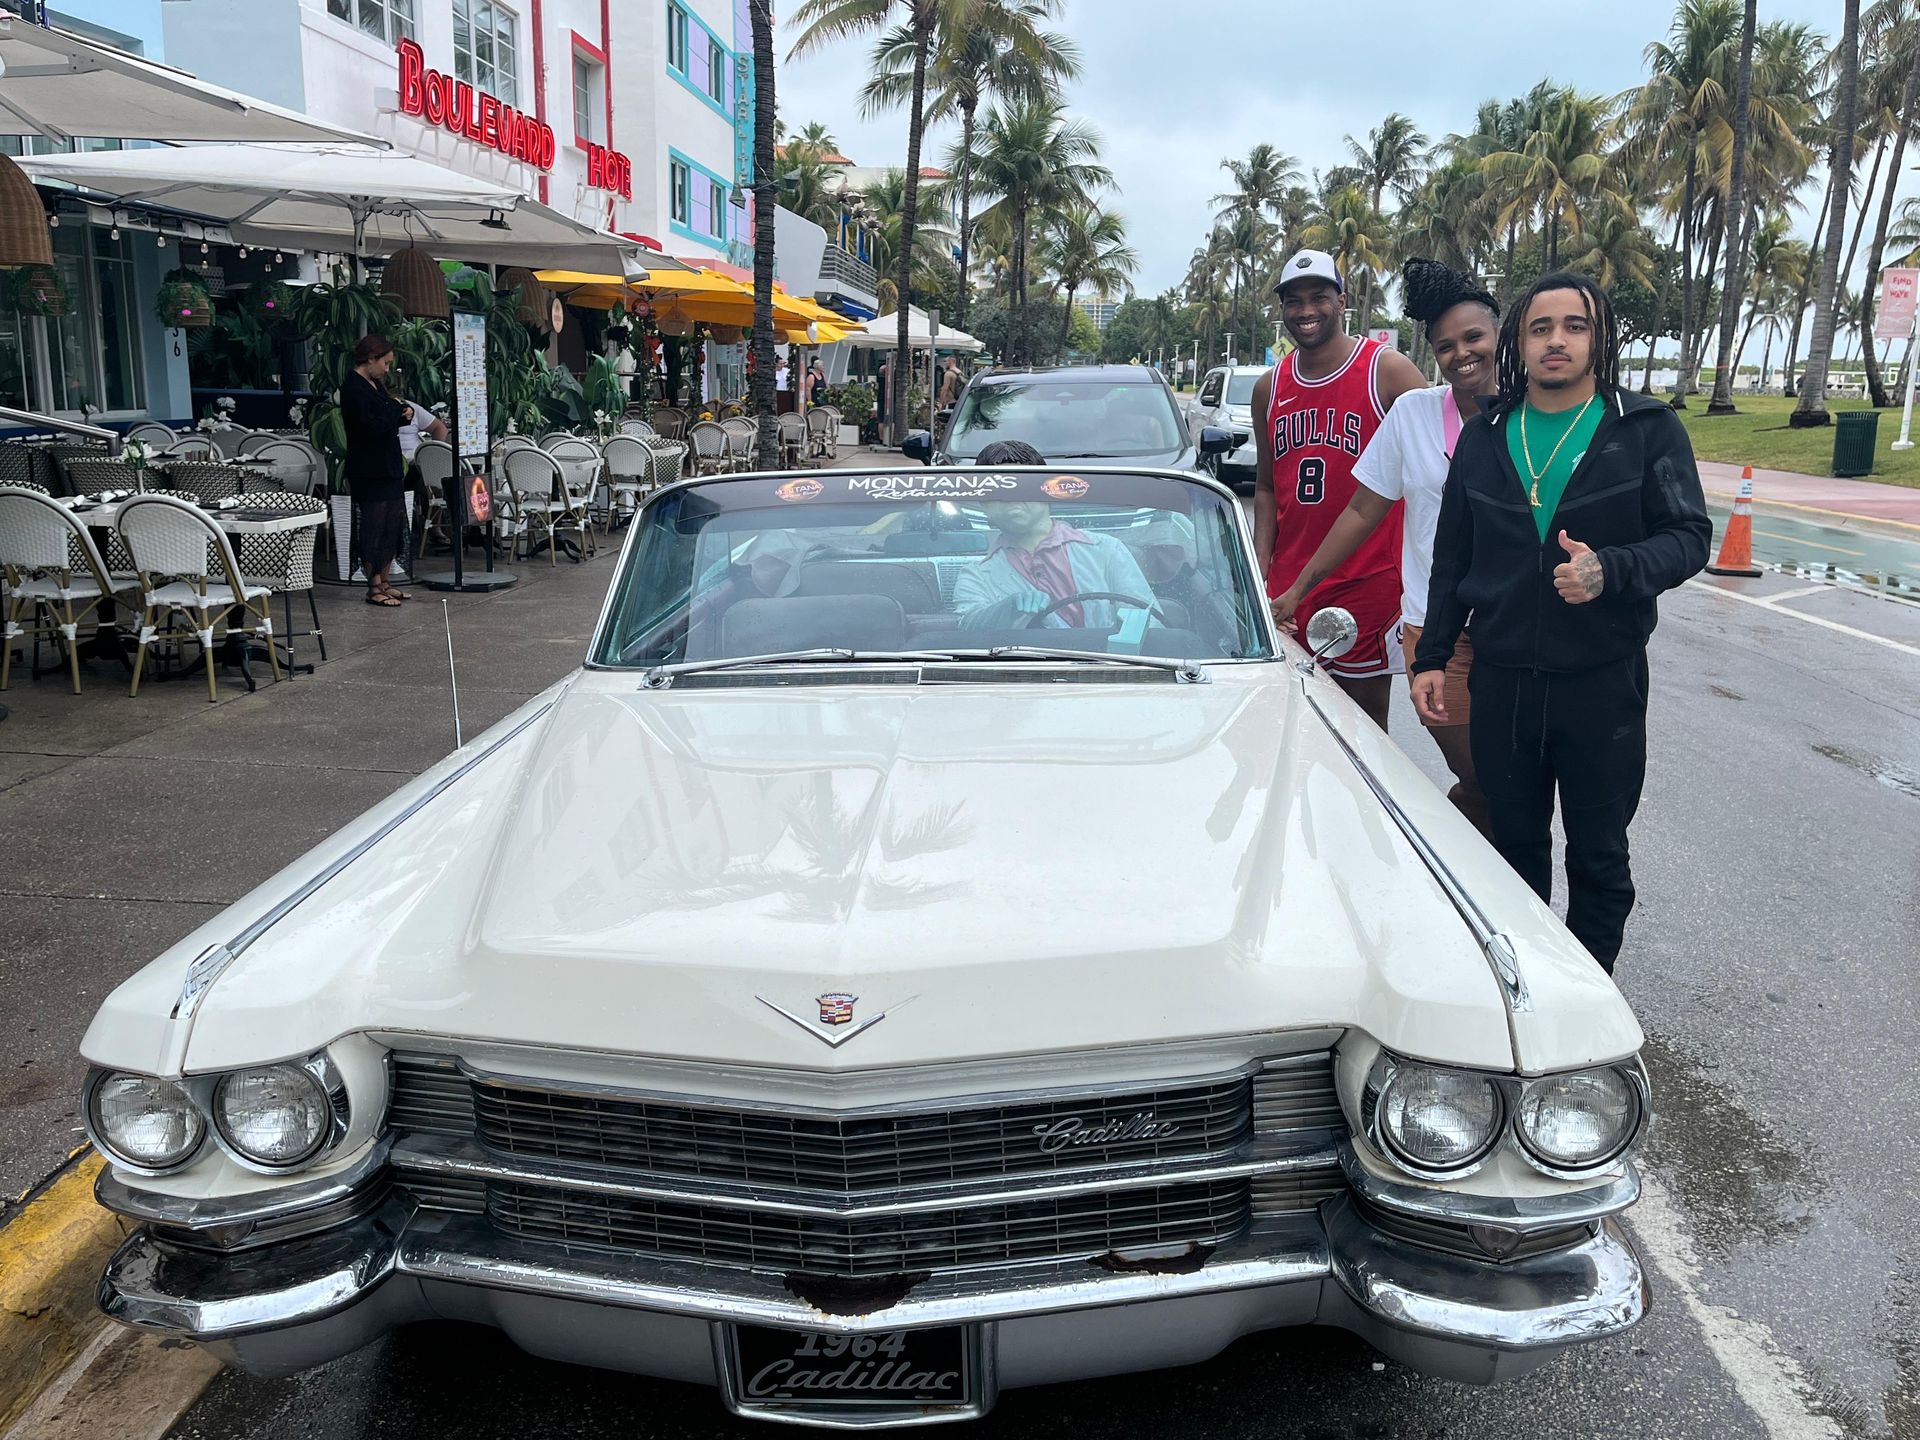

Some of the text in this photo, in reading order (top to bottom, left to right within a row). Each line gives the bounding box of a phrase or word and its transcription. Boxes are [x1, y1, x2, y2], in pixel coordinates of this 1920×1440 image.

[397, 37, 556, 171] BOULEVARD
[736, 55, 750, 188] STARLITE
[1889, 290, 1910, 298] WAVE
[1892, 276, 1912, 286] FIND
[1274, 408, 1361, 461] BULLS
[848, 475, 1018, 490] MONTANA'S
[866, 488, 993, 500] Restaurant
[1296, 456, 1326, 505] 8
[1032, 1112, 1180, 1154] Cadillac
[794, 1331, 907, 1358] 1964
[748, 1358, 959, 1396] Cadillac
